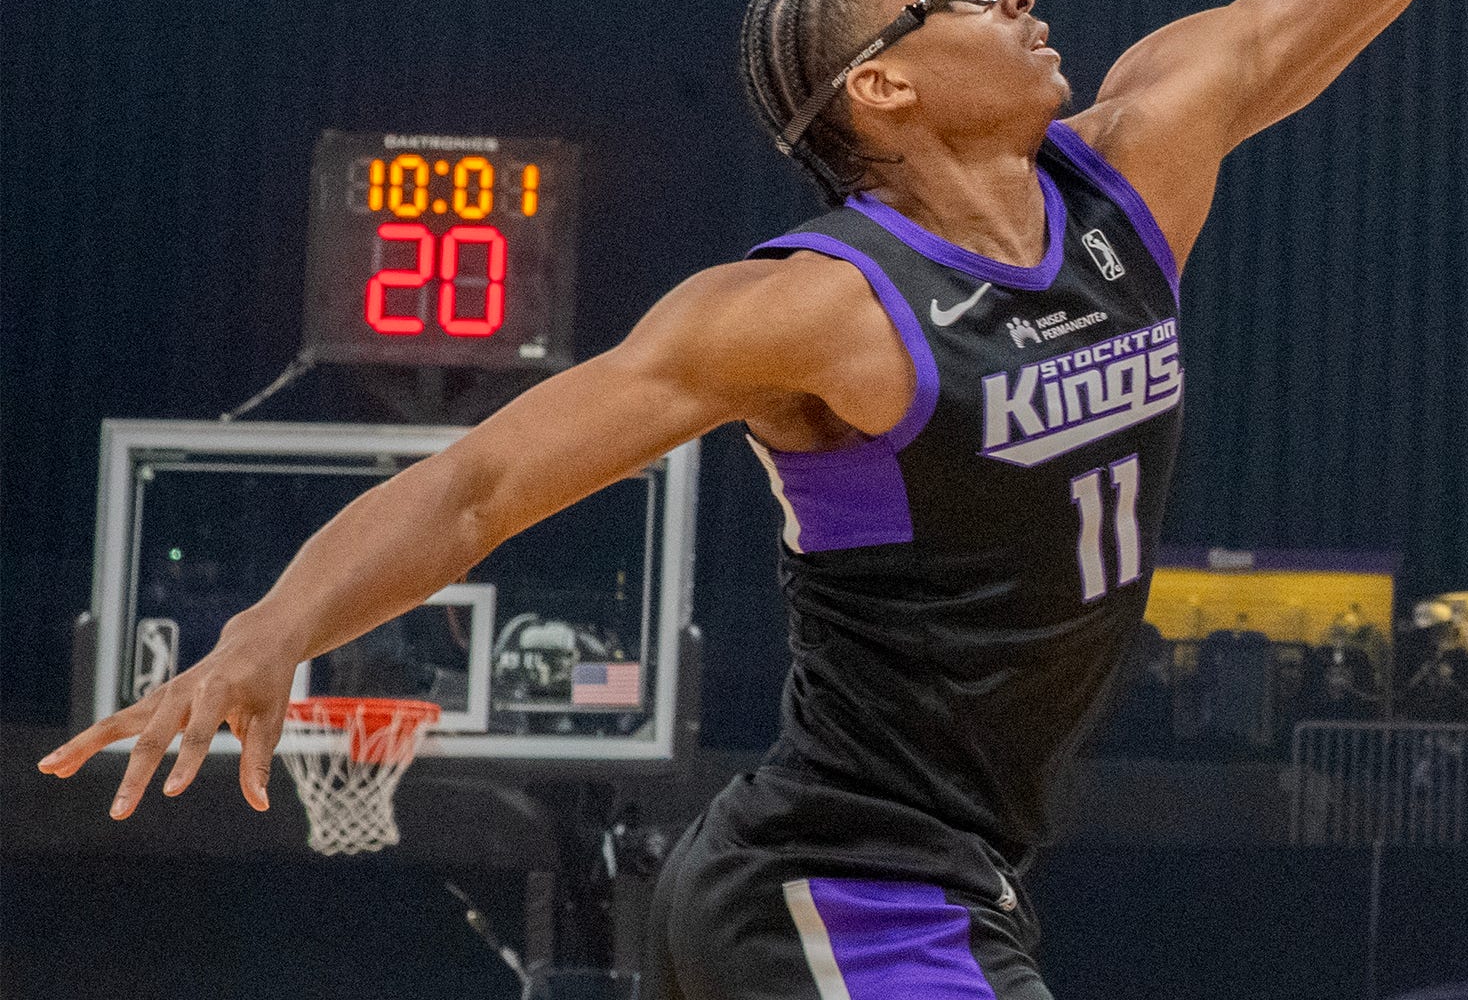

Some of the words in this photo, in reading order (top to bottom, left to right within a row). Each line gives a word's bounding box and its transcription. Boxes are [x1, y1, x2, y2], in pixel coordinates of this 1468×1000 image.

[850, 39, 884, 67] SPECS
[368, 154, 540, 219] 10:01
[365, 222, 508, 338] 20
[1036, 311, 1067, 329] KAISER
[1040, 320, 1177, 379] STOCKTON
[980, 342, 1185, 455] Kings
[1071, 454, 1140, 602] 11
